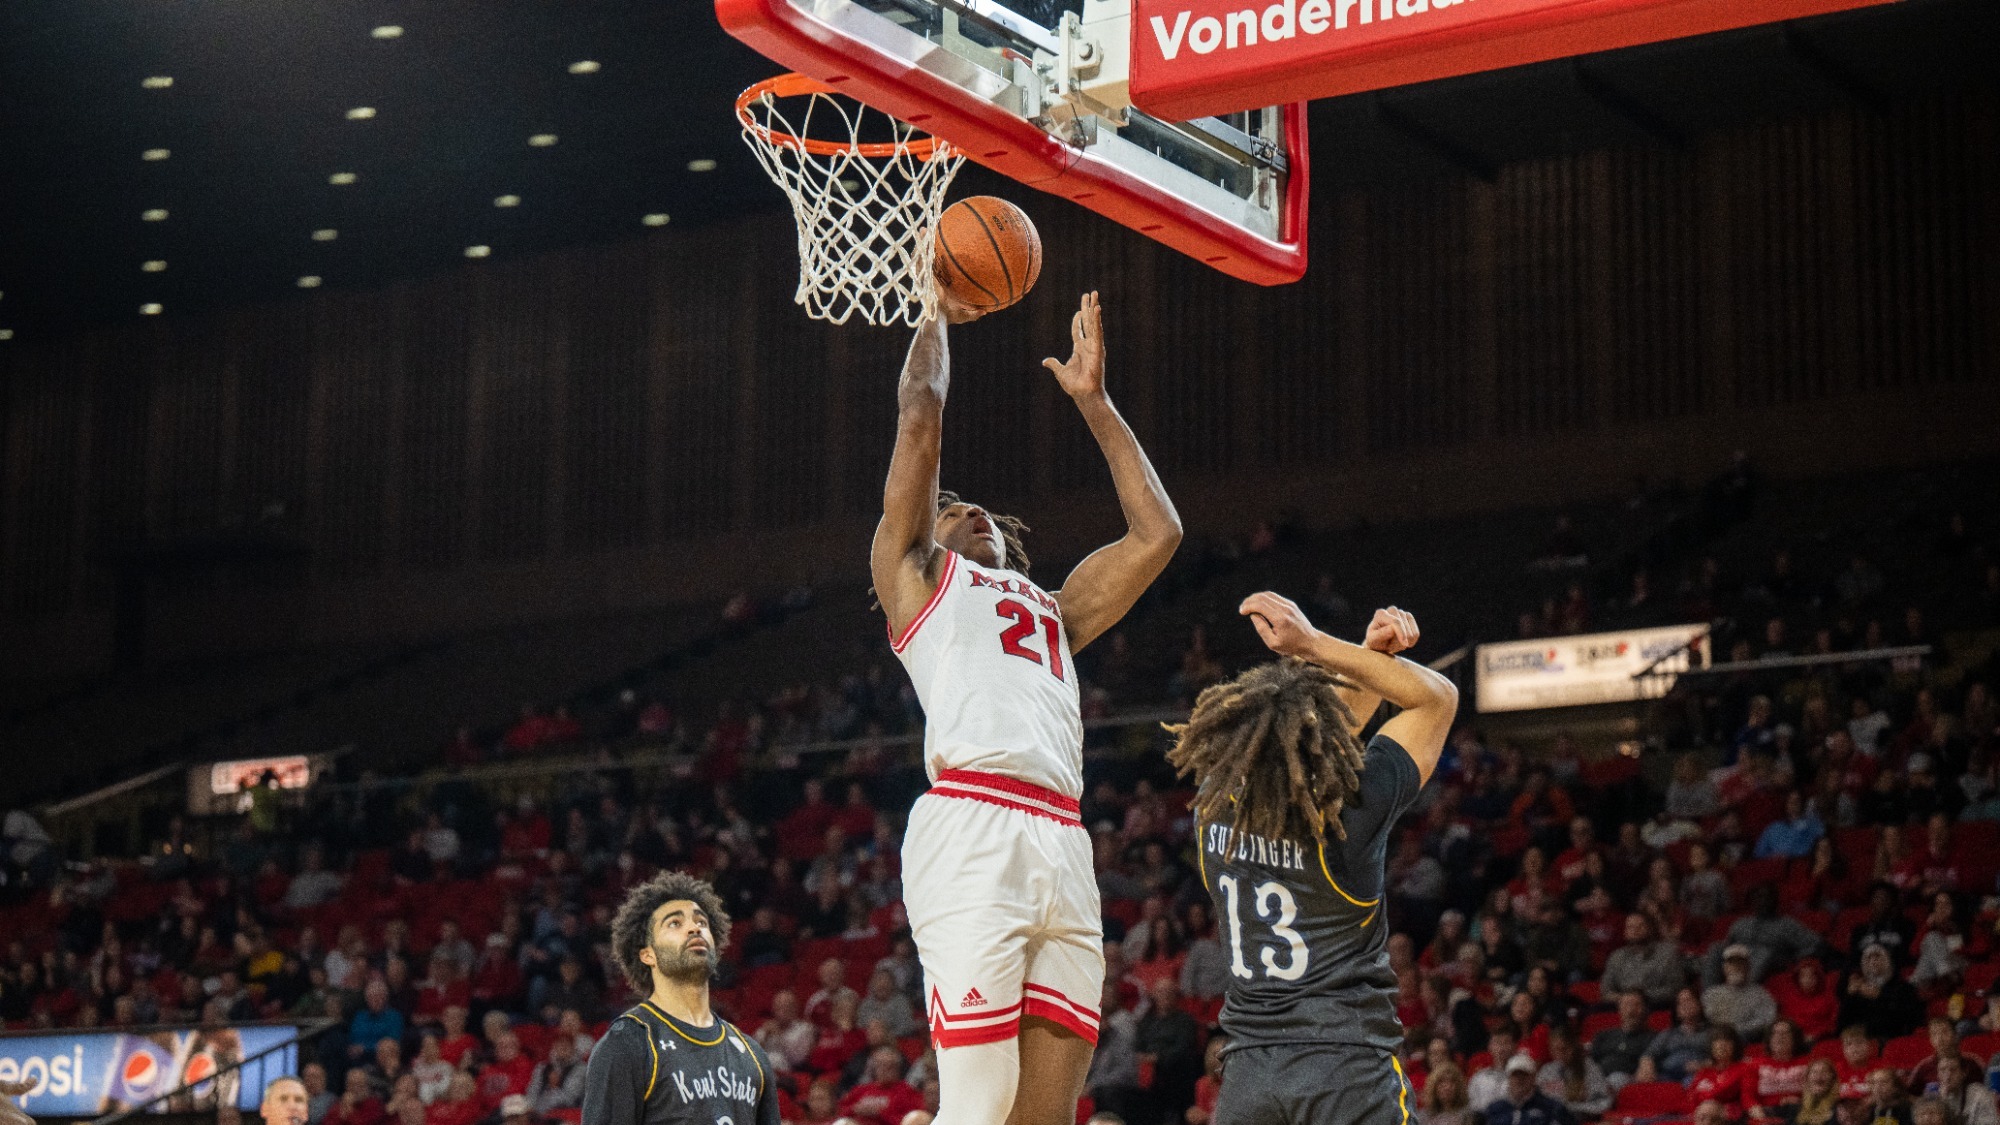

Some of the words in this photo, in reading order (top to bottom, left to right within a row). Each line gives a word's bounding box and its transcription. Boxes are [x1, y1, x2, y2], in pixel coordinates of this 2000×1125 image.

[1150, 0, 1476, 60] Vonderha
[968, 570, 1062, 620] MIAM
[995, 598, 1064, 683] 21
[1219, 874, 1309, 981] 13
[960, 999, 988, 1008] adidas
[0, 1043, 83, 1109] epsi
[672, 1069, 718, 1104] Kent
[717, 1066, 757, 1107] State
